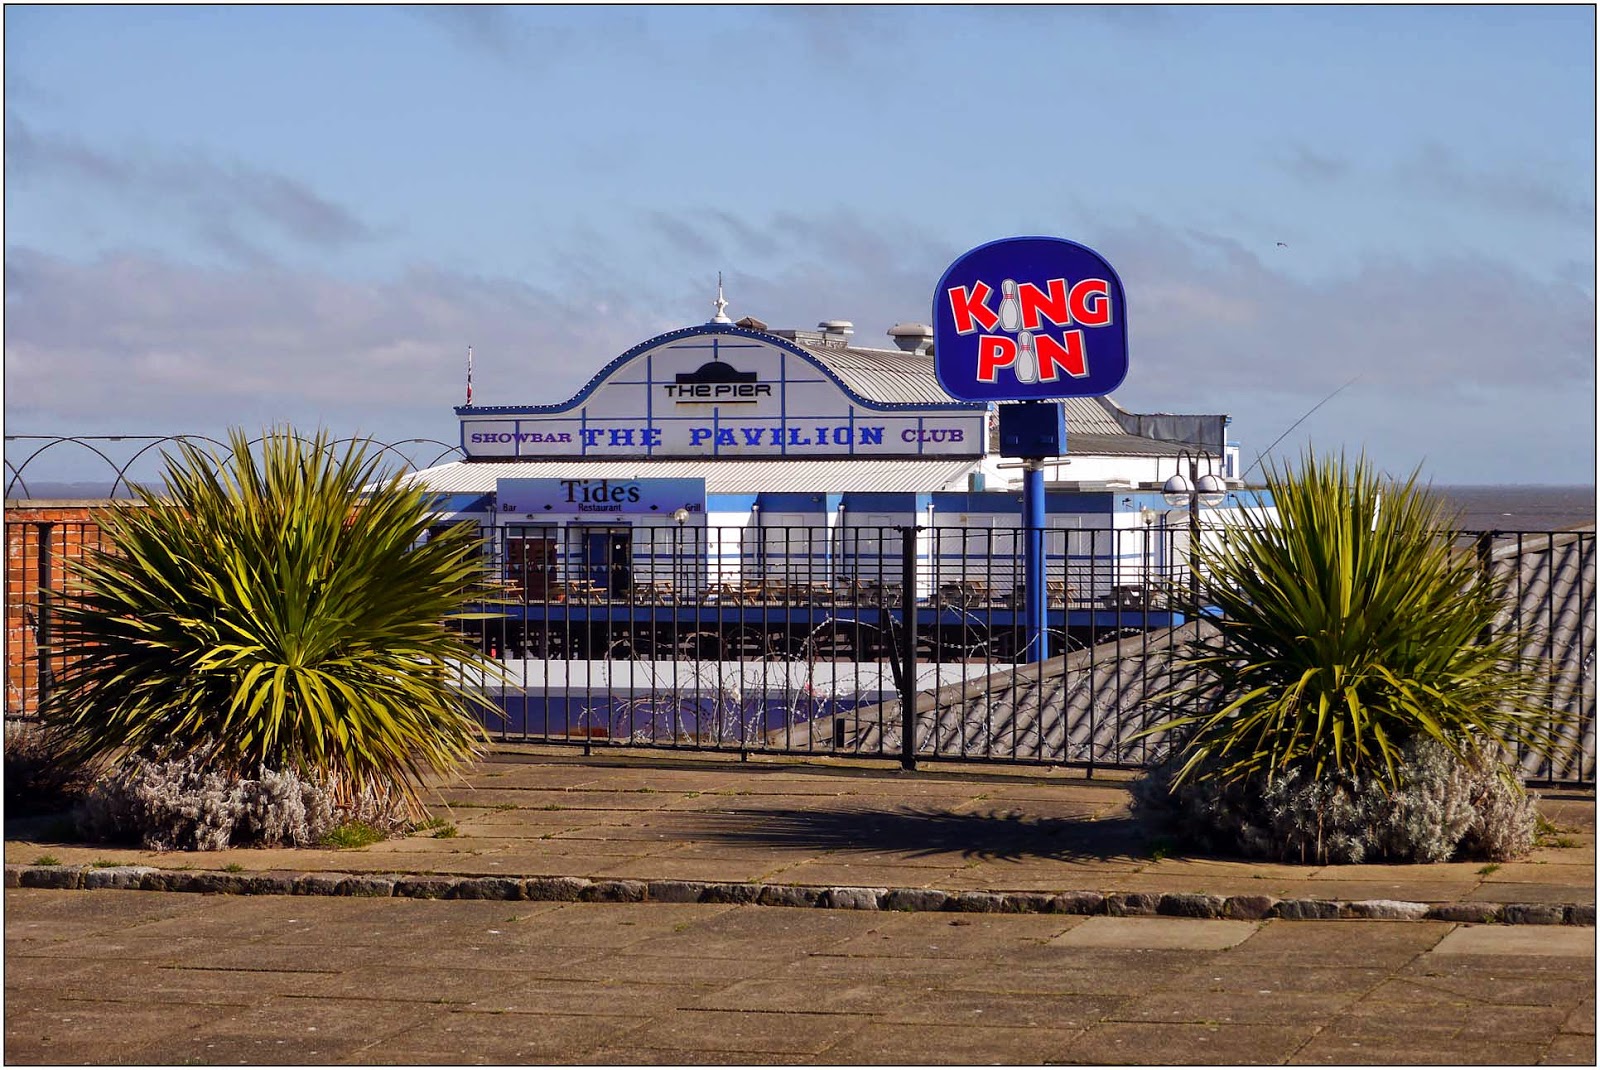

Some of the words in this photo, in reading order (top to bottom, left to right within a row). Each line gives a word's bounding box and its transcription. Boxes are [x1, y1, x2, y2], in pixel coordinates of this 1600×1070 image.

[948, 278, 1113, 336] KING
[976, 329, 1090, 384] PIN
[471, 432, 573, 443] SHOWBAR
[579, 428, 662, 446] THE
[689, 426, 886, 447] PAVILION
[901, 429, 965, 442] CLUB
[560, 479, 641, 504] Tides
[502, 503, 517, 512] Bar
[578, 503, 622, 512] Restaurant
[684, 503, 701, 512] Grill
